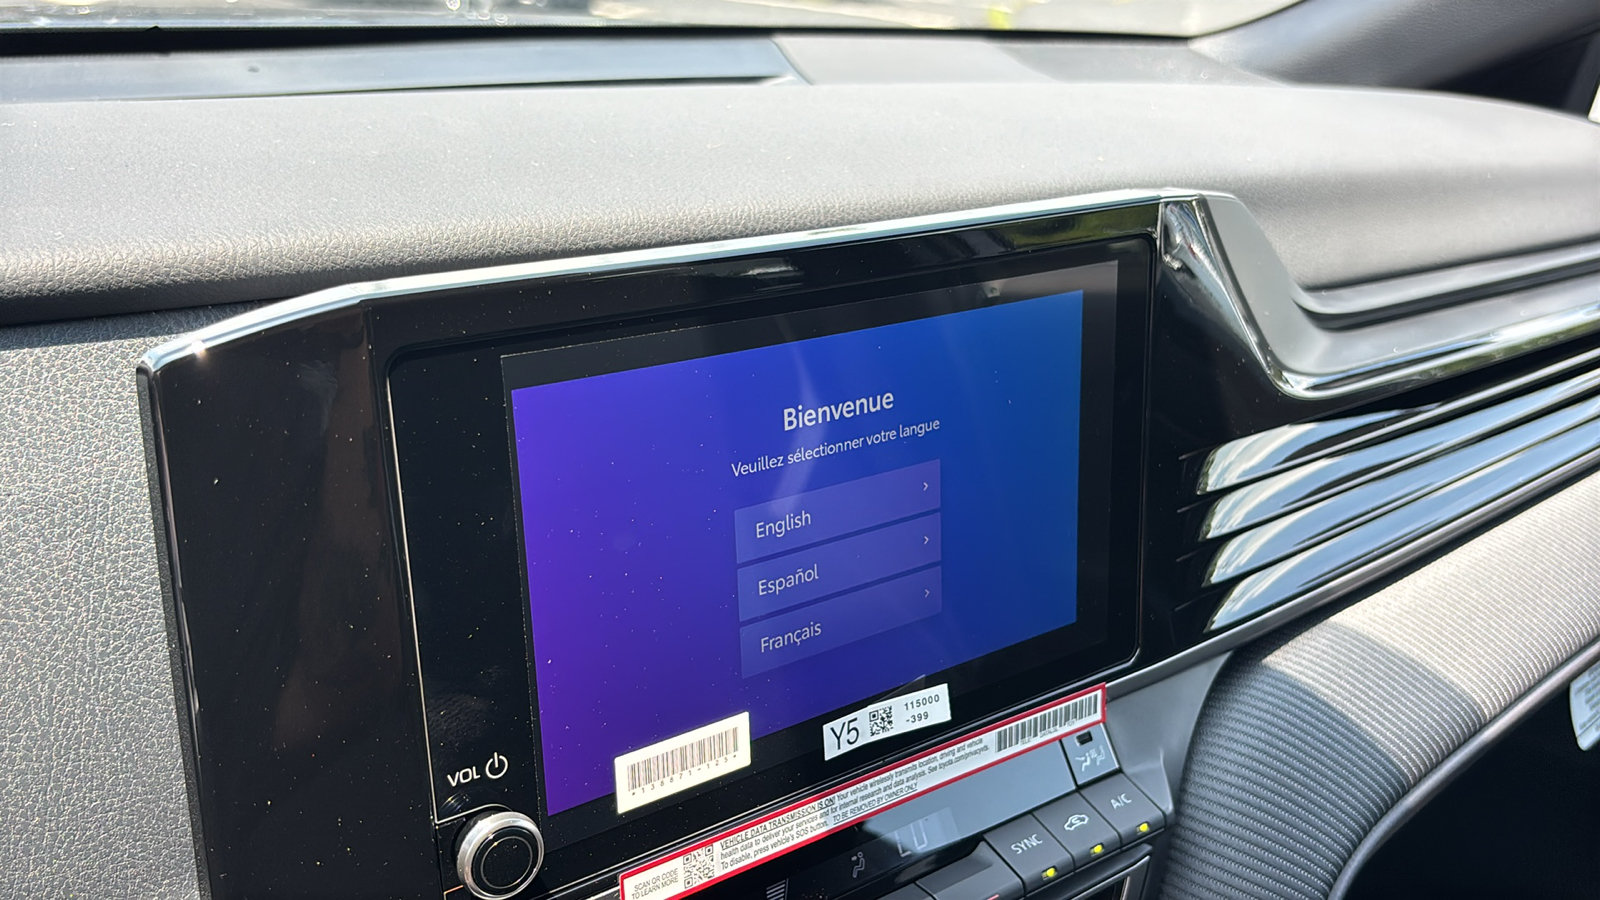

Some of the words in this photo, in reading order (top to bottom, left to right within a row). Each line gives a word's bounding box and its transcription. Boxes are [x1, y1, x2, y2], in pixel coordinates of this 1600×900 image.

[783, 392, 895, 431] Bienvenue
[731, 456, 784, 477] Veuillez
[787, 436, 864, 461] sélectionner
[866, 428, 897, 446] votre
[899, 420, 940, 438] langue
[755, 510, 812, 538] English
[758, 563, 819, 596] Español
[760, 622, 822, 653] Français
[904, 694, 940, 711] 115000
[906, 711, 929, 724] -399
[830, 717, 860, 750] Y5
[447, 766, 480, 787] VOL
[720, 832, 748, 849] VEHICLE
[750, 825, 767, 839] DATA
[768, 806, 816, 829] TRANSMISSION
[817, 800, 824, 809] IS
[837, 791, 849, 801] Your
[850, 784, 868, 796] vehicle
[869, 774, 894, 788] wirelessly
[895, 764, 917, 778] transmits
[957, 744, 966, 753] and
[833, 814, 841, 822] TO
[841, 810, 849, 818] BE
[849, 799, 875, 815] REMOVED
[876, 796, 884, 805] BY
[884, 788, 904, 801] OWNER
[904, 781, 918, 793] ONLY
[1110, 793, 1132, 810] A/C
[720, 847, 739, 860] health
[740, 841, 753, 852] data
[761, 831, 781, 843] deliver
[781, 825, 795, 839] your
[796, 815, 818, 829] services
[819, 808, 829, 818] and
[830, 804, 838, 814] for
[839, 798, 858, 811] internal
[860, 787, 882, 801] research
[882, 782, 892, 793] and
[894, 777, 905, 788] data
[721, 861, 729, 870] To
[729, 853, 752, 867] disable,
[753, 846, 769, 858] press
[770, 834, 795, 849] vehicle's
[796, 827, 809, 838] SOS
[1010, 833, 1043, 855] SYNC
[631, 892, 640, 900] TO
[641, 883, 661, 897] LEARN
[661, 875, 679, 889] MORE
[634, 880, 651, 892] SCAN
[651, 875, 661, 884] QR
[661, 868, 679, 880] CODE
